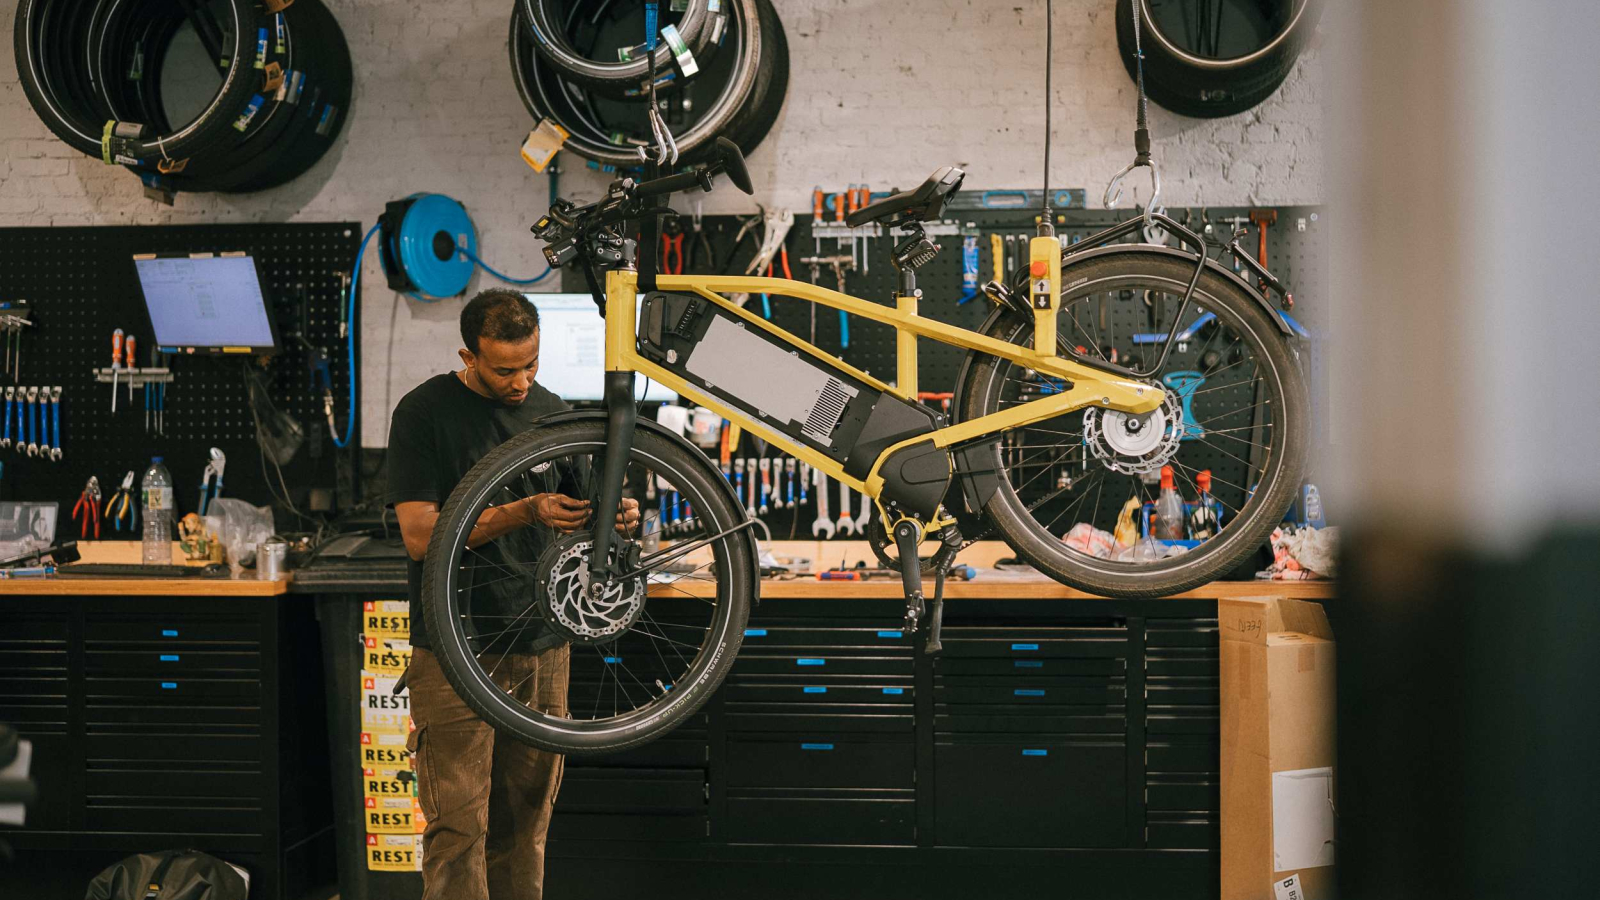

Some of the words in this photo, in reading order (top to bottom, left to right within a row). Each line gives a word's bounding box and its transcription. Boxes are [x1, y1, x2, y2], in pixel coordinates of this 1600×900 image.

[369, 617, 409, 628] REST
[370, 653, 411, 667] REST
[368, 695, 409, 709] REST
[366, 749, 408, 762] REST
[370, 781, 410, 793] REST
[370, 813, 411, 825] REST
[372, 850, 412, 862] REST
